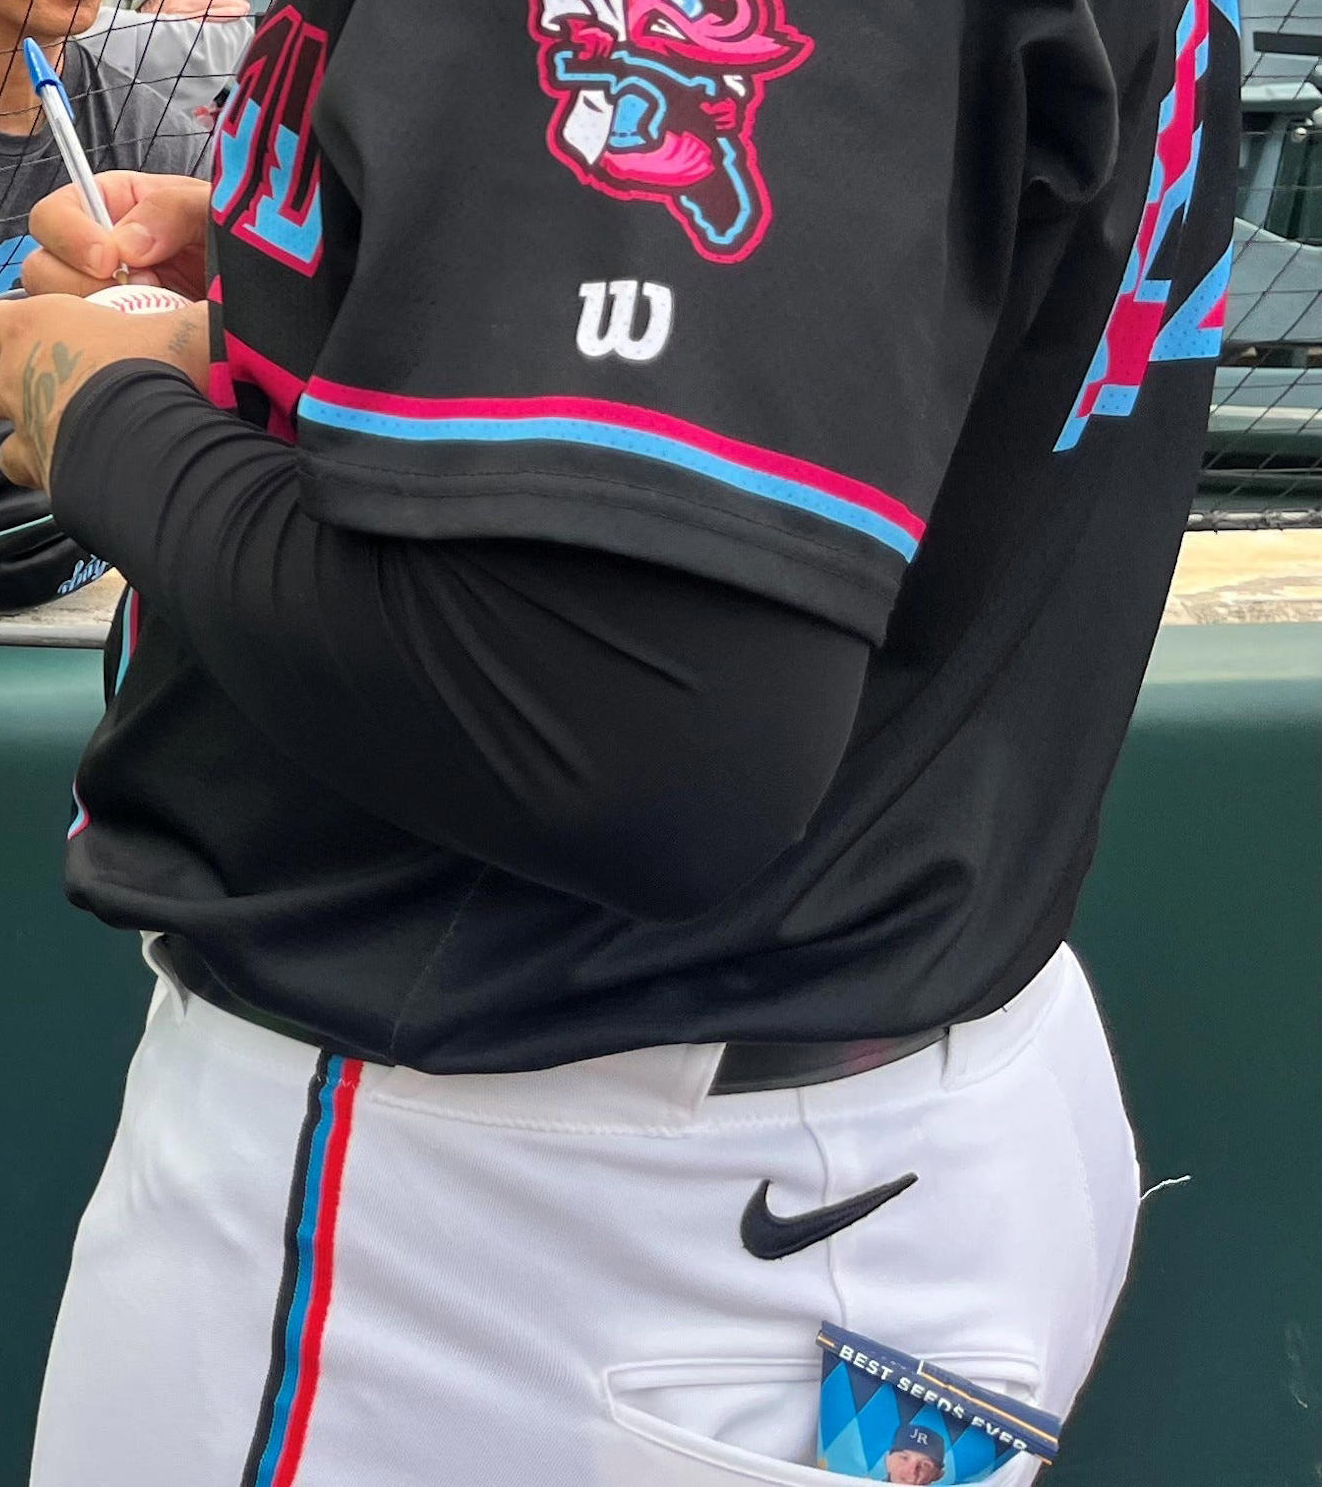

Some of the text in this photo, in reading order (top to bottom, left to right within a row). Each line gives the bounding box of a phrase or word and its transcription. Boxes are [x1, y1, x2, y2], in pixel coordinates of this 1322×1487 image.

[838, 1343, 895, 1382] BEST
[896, 1376, 966, 1420] SEEDS
[908, 1427, 929, 1446] JR
